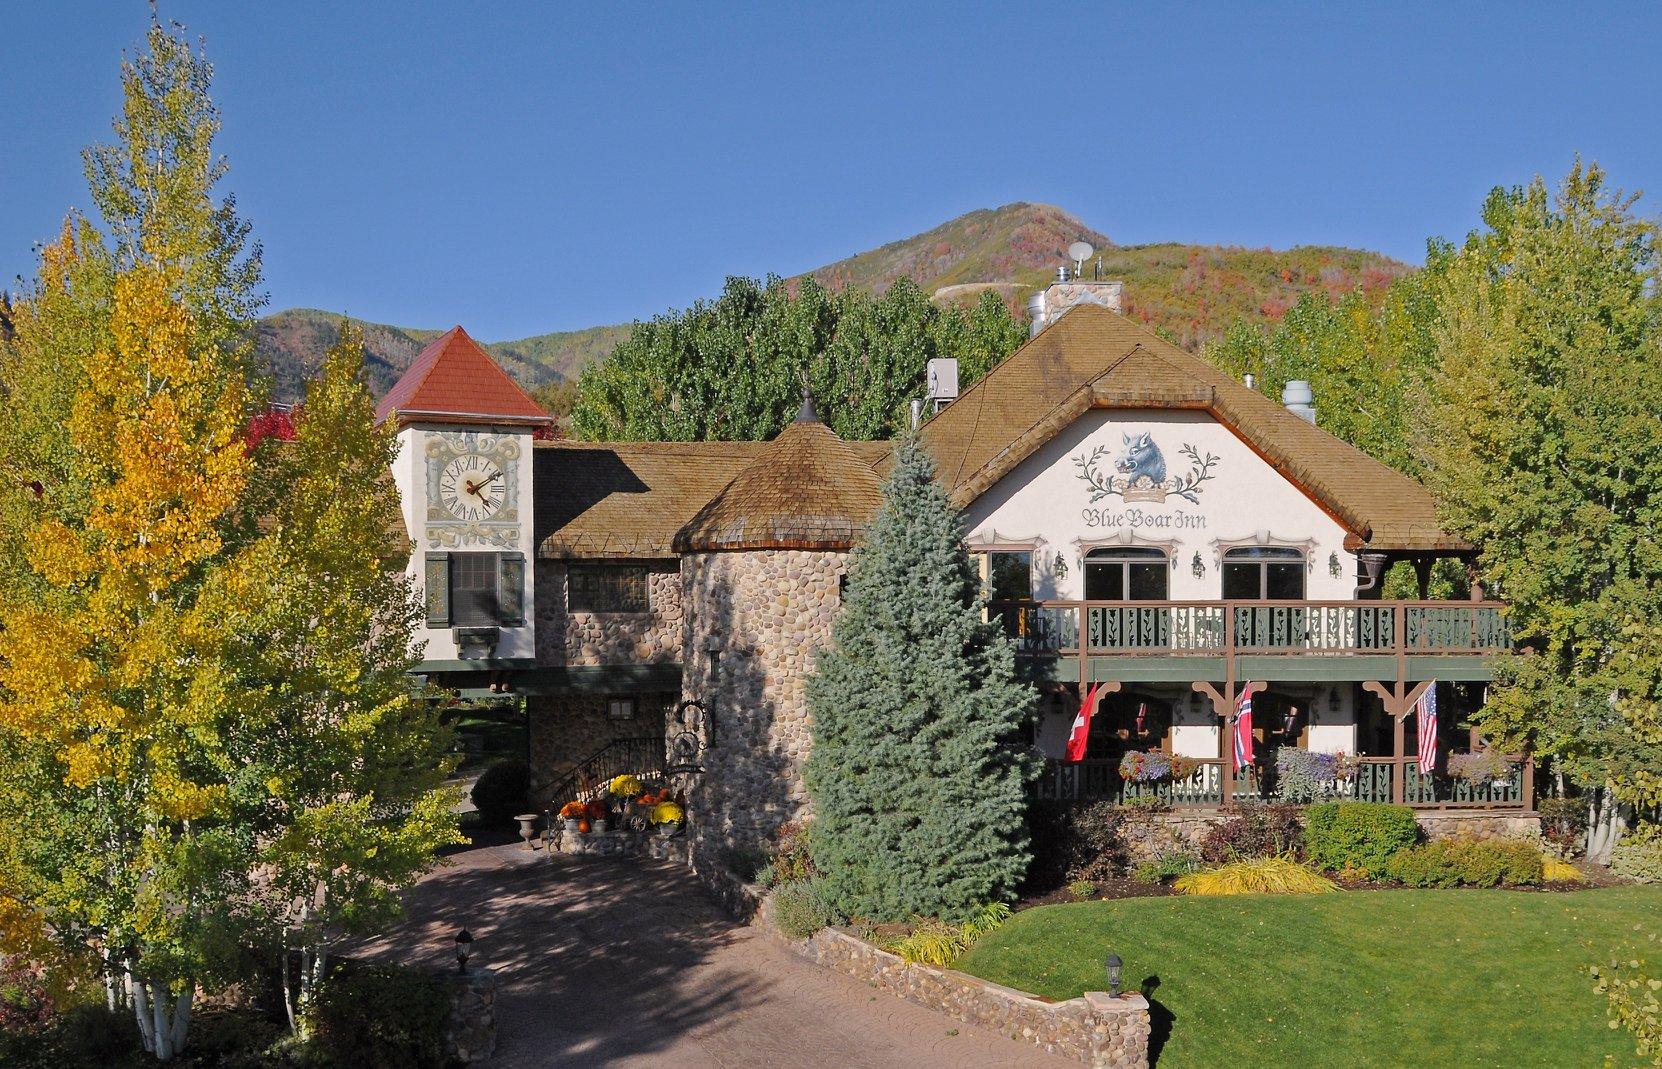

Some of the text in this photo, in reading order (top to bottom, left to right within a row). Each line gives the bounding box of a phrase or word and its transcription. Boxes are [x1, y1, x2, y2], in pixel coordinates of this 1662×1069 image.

[465, 456, 478, 470] XII
[491, 485, 505, 493] III
[1082, 508, 1208, 529] Blue Boar Inn
